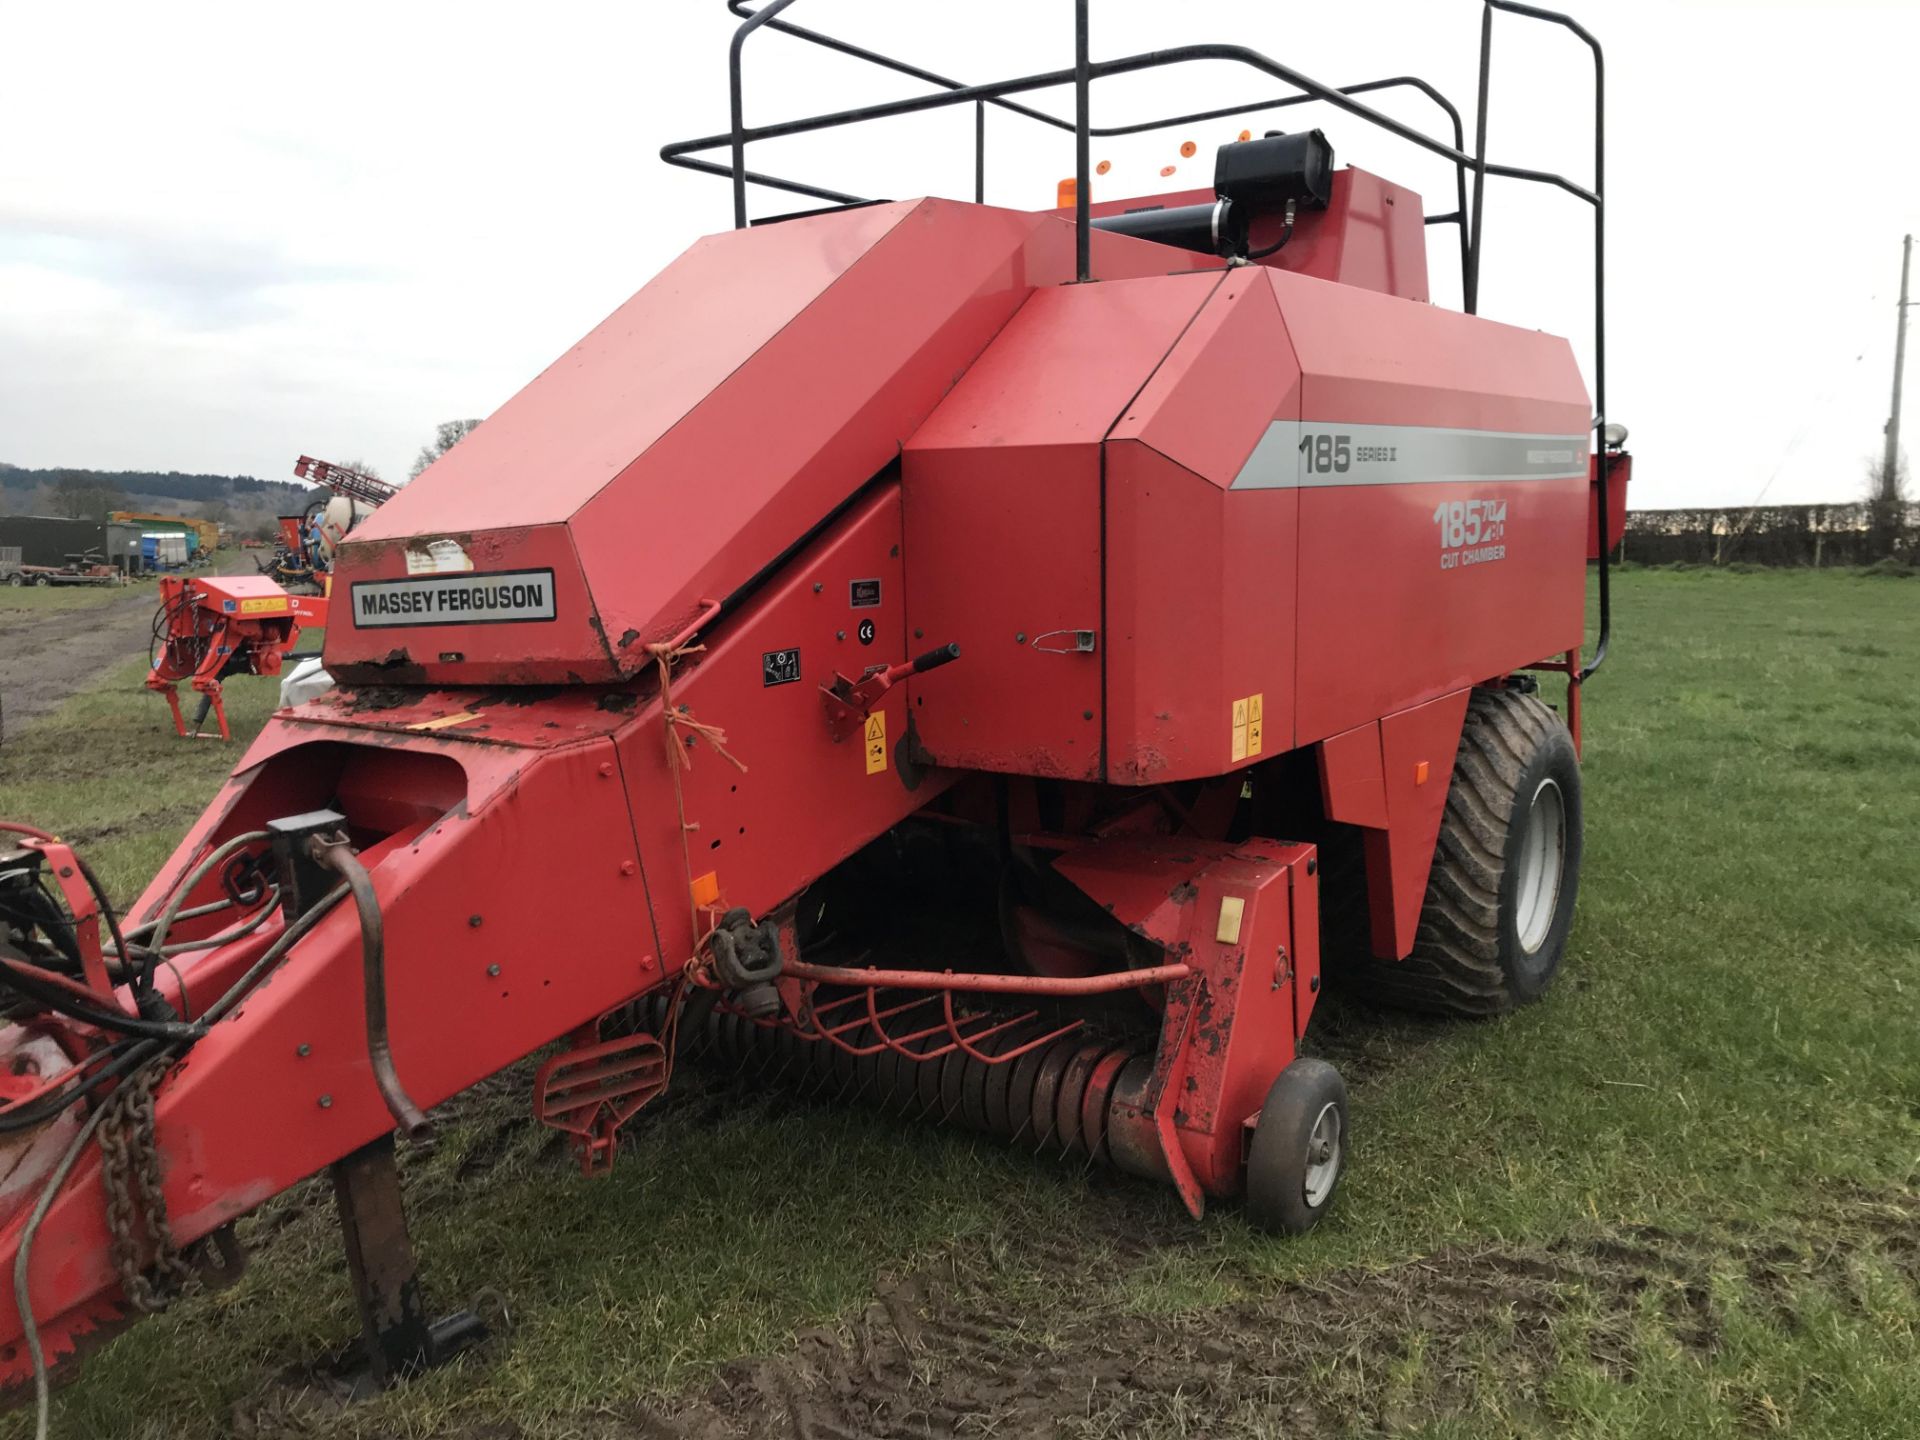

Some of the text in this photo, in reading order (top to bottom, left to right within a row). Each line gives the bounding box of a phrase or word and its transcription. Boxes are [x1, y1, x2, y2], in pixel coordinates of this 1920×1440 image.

[1299, 434, 1351, 474] 185
[1356, 446, 1388, 462] SERIES
[1433, 500, 1481, 549] 185
[1440, 545, 1505, 569] CUT CHAMBER
[362, 584, 543, 616] MASSEY FERGUSON
